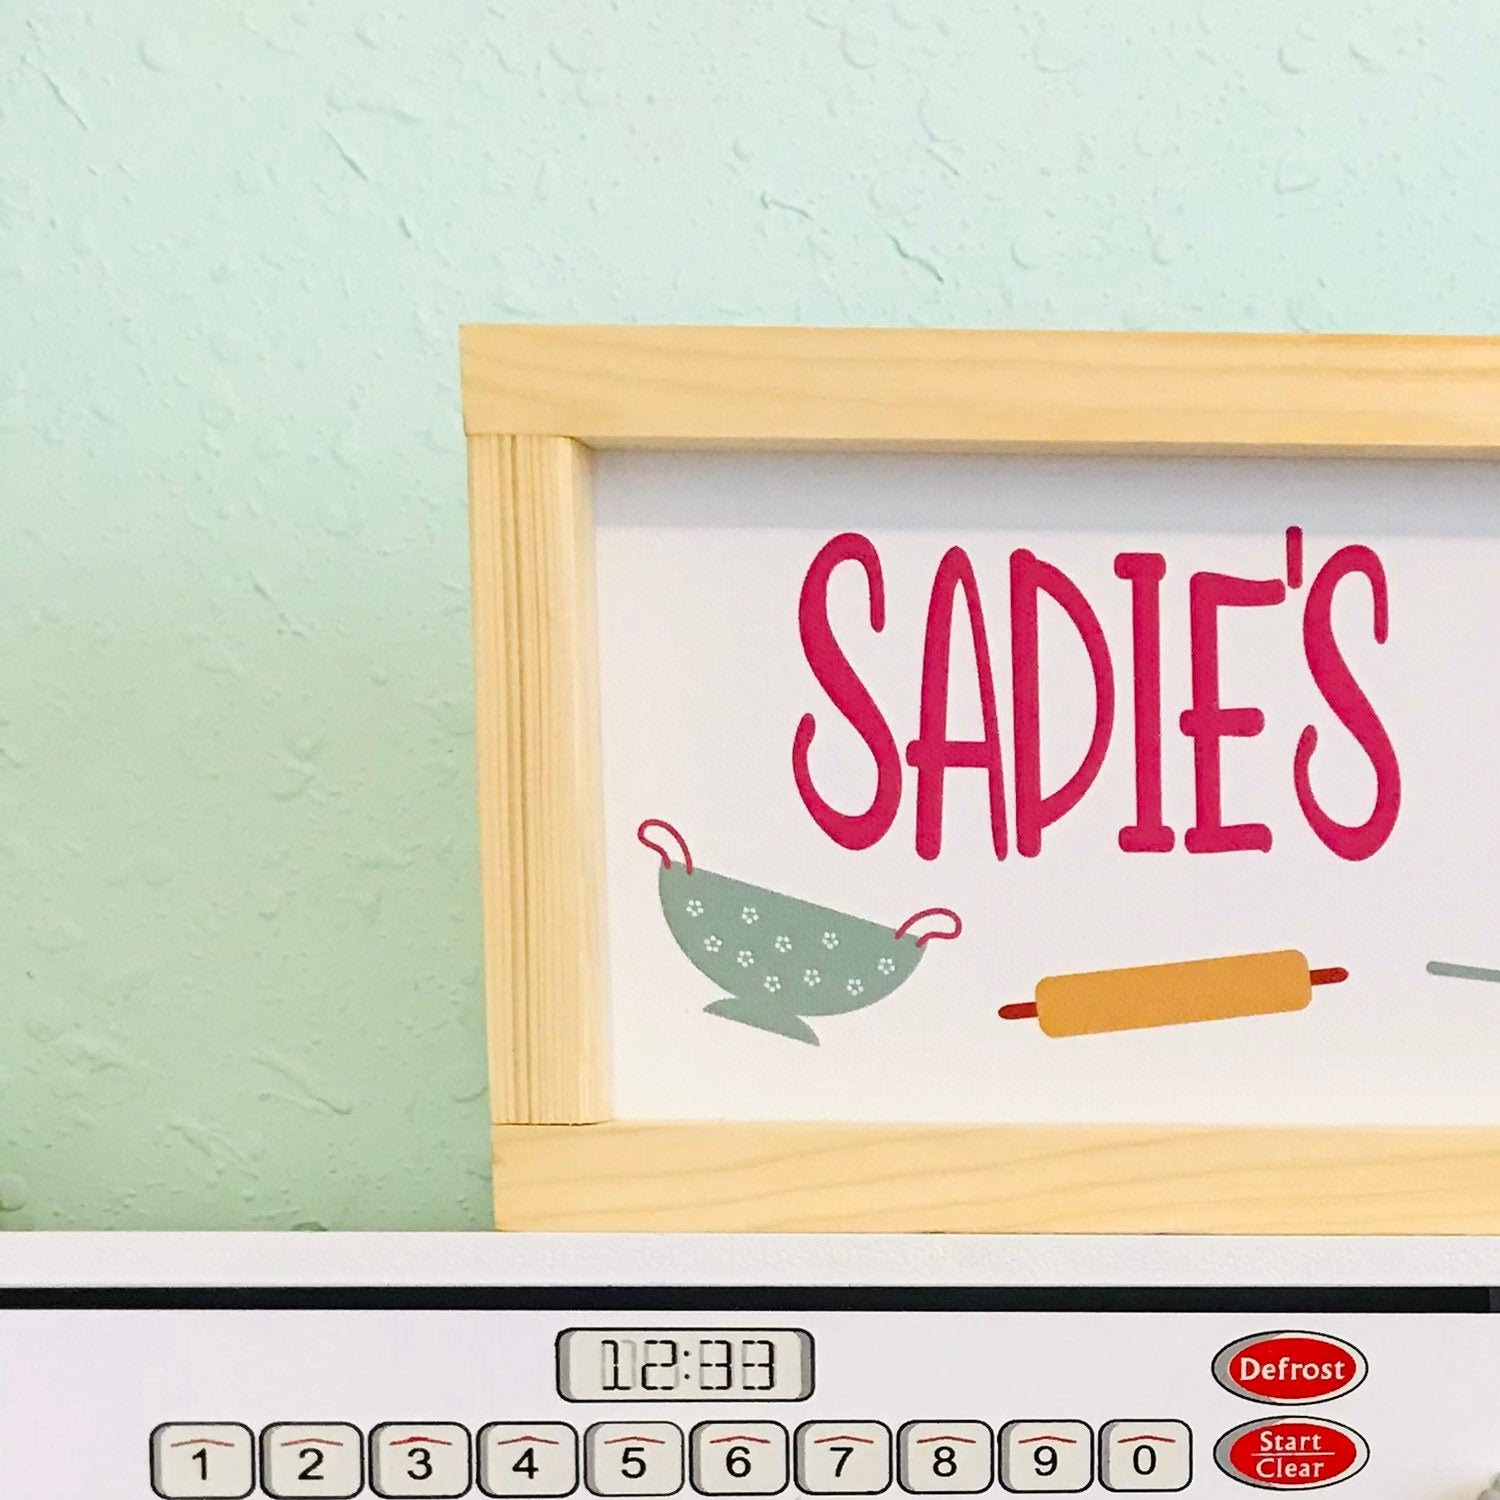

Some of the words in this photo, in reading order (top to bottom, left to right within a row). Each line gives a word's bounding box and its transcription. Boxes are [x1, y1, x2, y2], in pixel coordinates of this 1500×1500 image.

[793, 527, 1400, 860] SADIE'S
[602, 1340, 774, 1390] 12:33
[1241, 1357, 1344, 1380] Defrost
[1261, 1431, 1320, 1451] Start
[193, 1449, 206, 1480] 1
[298, 1448, 323, 1480] 2
[408, 1448, 432, 1480] 3
[512, 1448, 538, 1479] 4
[622, 1447, 646, 1478] 5
[726, 1446, 751, 1477] 6
[830, 1447, 853, 1477] 7
[933, 1446, 957, 1477] 8
[1034, 1446, 1057, 1476] 9
[1133, 1445, 1156, 1475] 0
[1257, 1458, 1323, 1477] Clear
